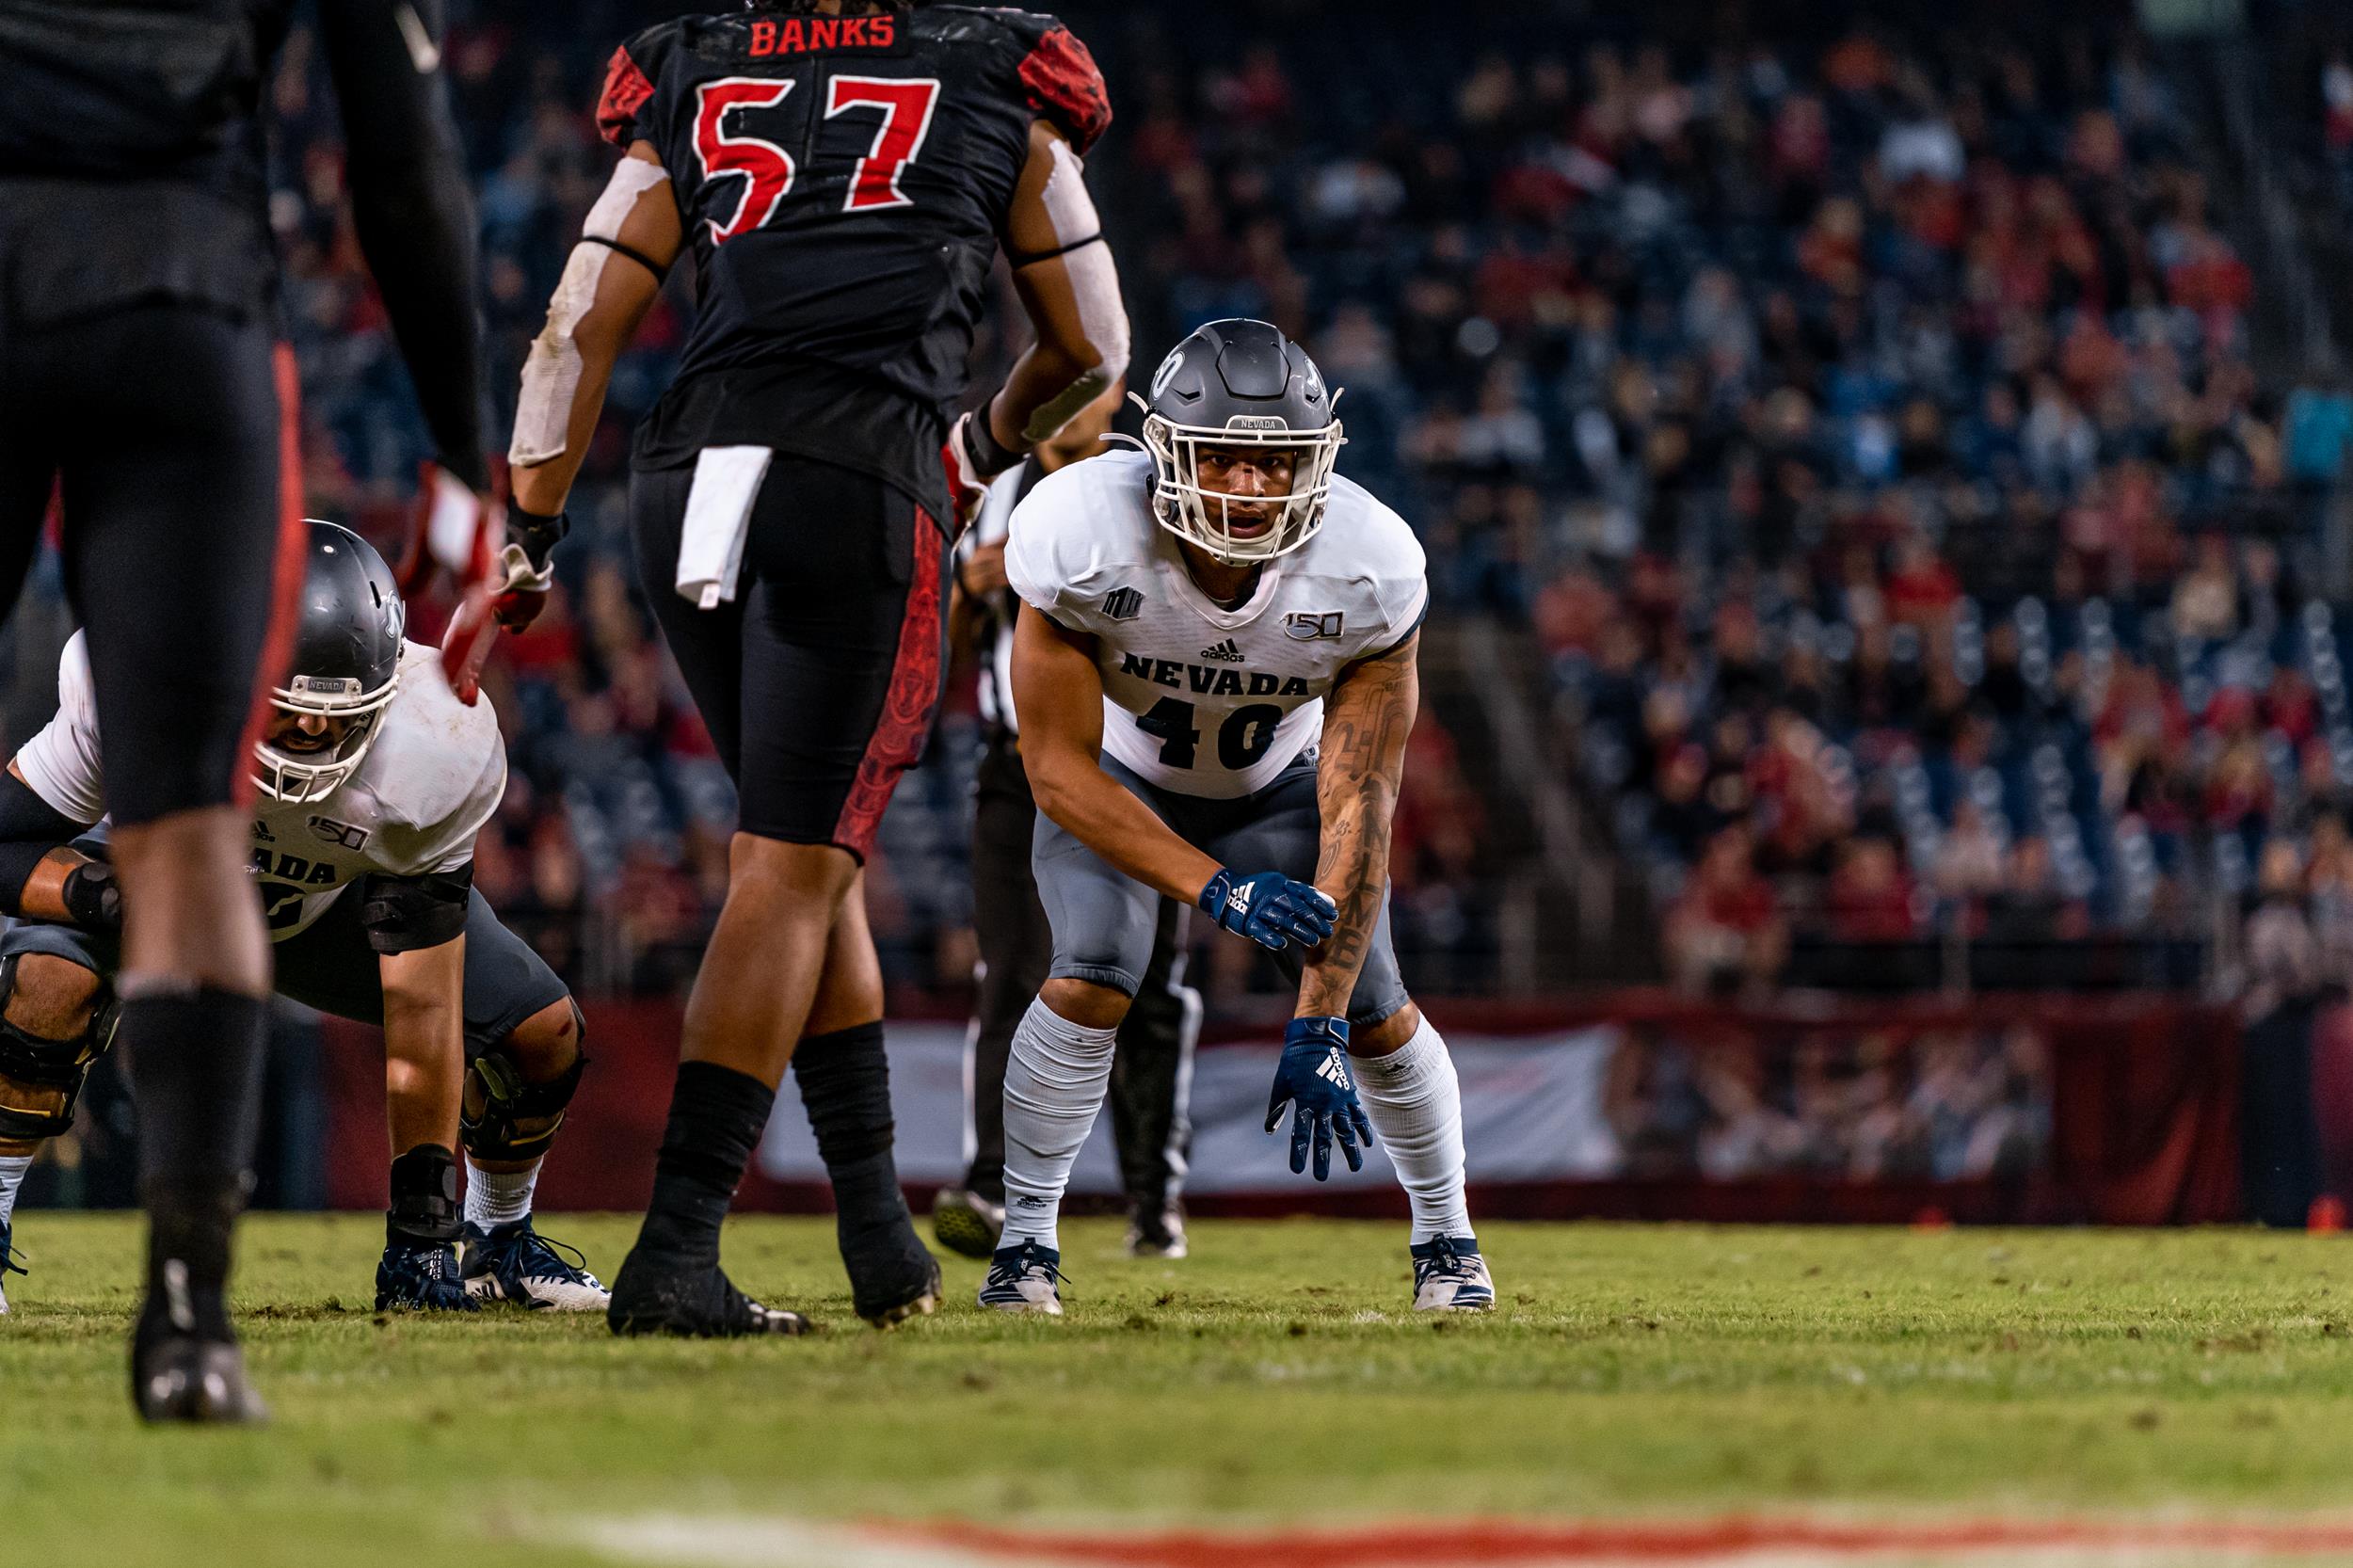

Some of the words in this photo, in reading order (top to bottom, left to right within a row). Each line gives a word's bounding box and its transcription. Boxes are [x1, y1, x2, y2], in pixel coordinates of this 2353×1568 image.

[749, 15, 893, 56] BANKS
[693, 75, 940, 246] 57
[1241, 419, 1276, 429] NEVADA
[1121, 651, 1309, 696] NEVADA
[1200, 649, 1245, 663] adidas
[309, 680, 344, 691] NEVADA
[1135, 696, 1284, 771] 40
[1330, 1046, 1351, 1091] adidas
